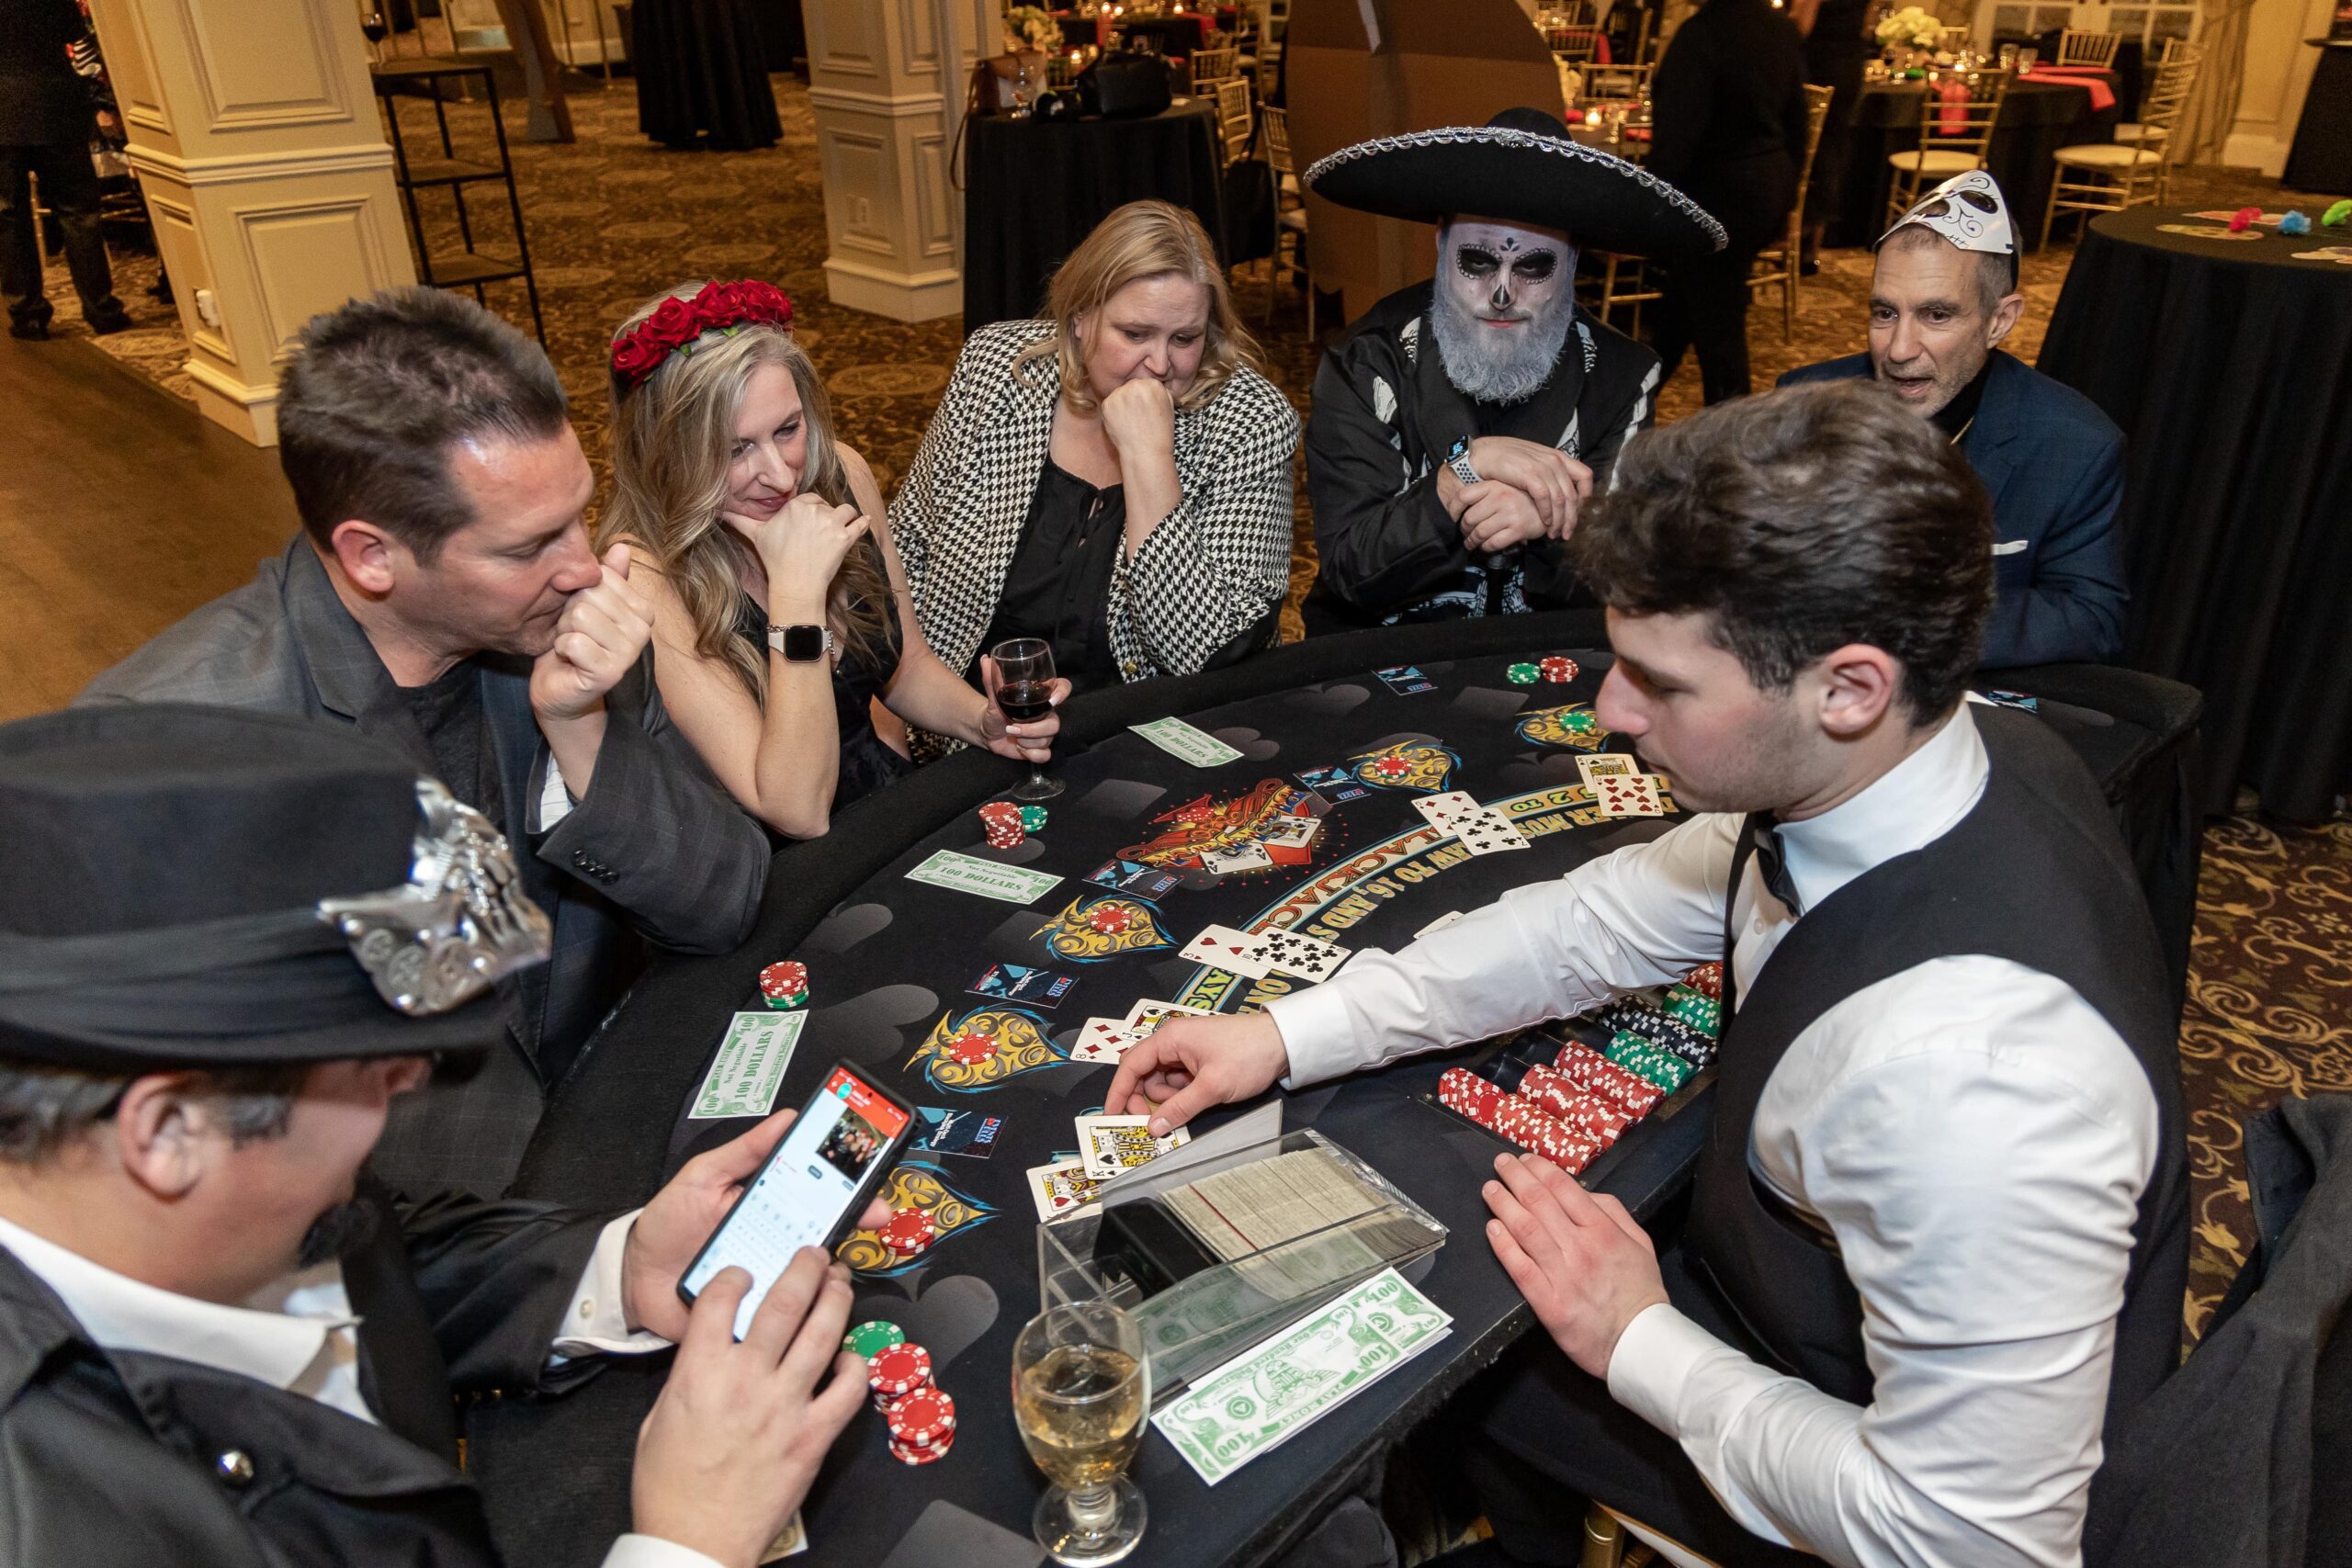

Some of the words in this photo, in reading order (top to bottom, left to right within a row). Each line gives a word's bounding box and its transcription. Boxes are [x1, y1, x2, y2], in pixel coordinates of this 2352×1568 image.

[1511, 799, 1544, 812] TO
[1547, 791, 1574, 806] 2
[1515, 812, 1574, 840] MUS
[939, 866, 963, 876] 100
[965, 872, 1024, 891] DOLLARS
[1395, 861, 1439, 883] TO
[1320, 894, 1379, 929] AND
[1184, 968, 1236, 1010] AYS
[740, 1016, 755, 1032] 100
[742, 1031, 774, 1077] DOLLARS
[735, 1081, 753, 1099] 100
[704, 1097, 721, 1113] 100
[1091, 1169, 1105, 1178] K
[1369, 1281, 1398, 1302] 100
[1255, 1337, 1293, 1368] Hundred
[1359, 1344, 1389, 1367] 100
[1216, 1431, 1250, 1458] 100
